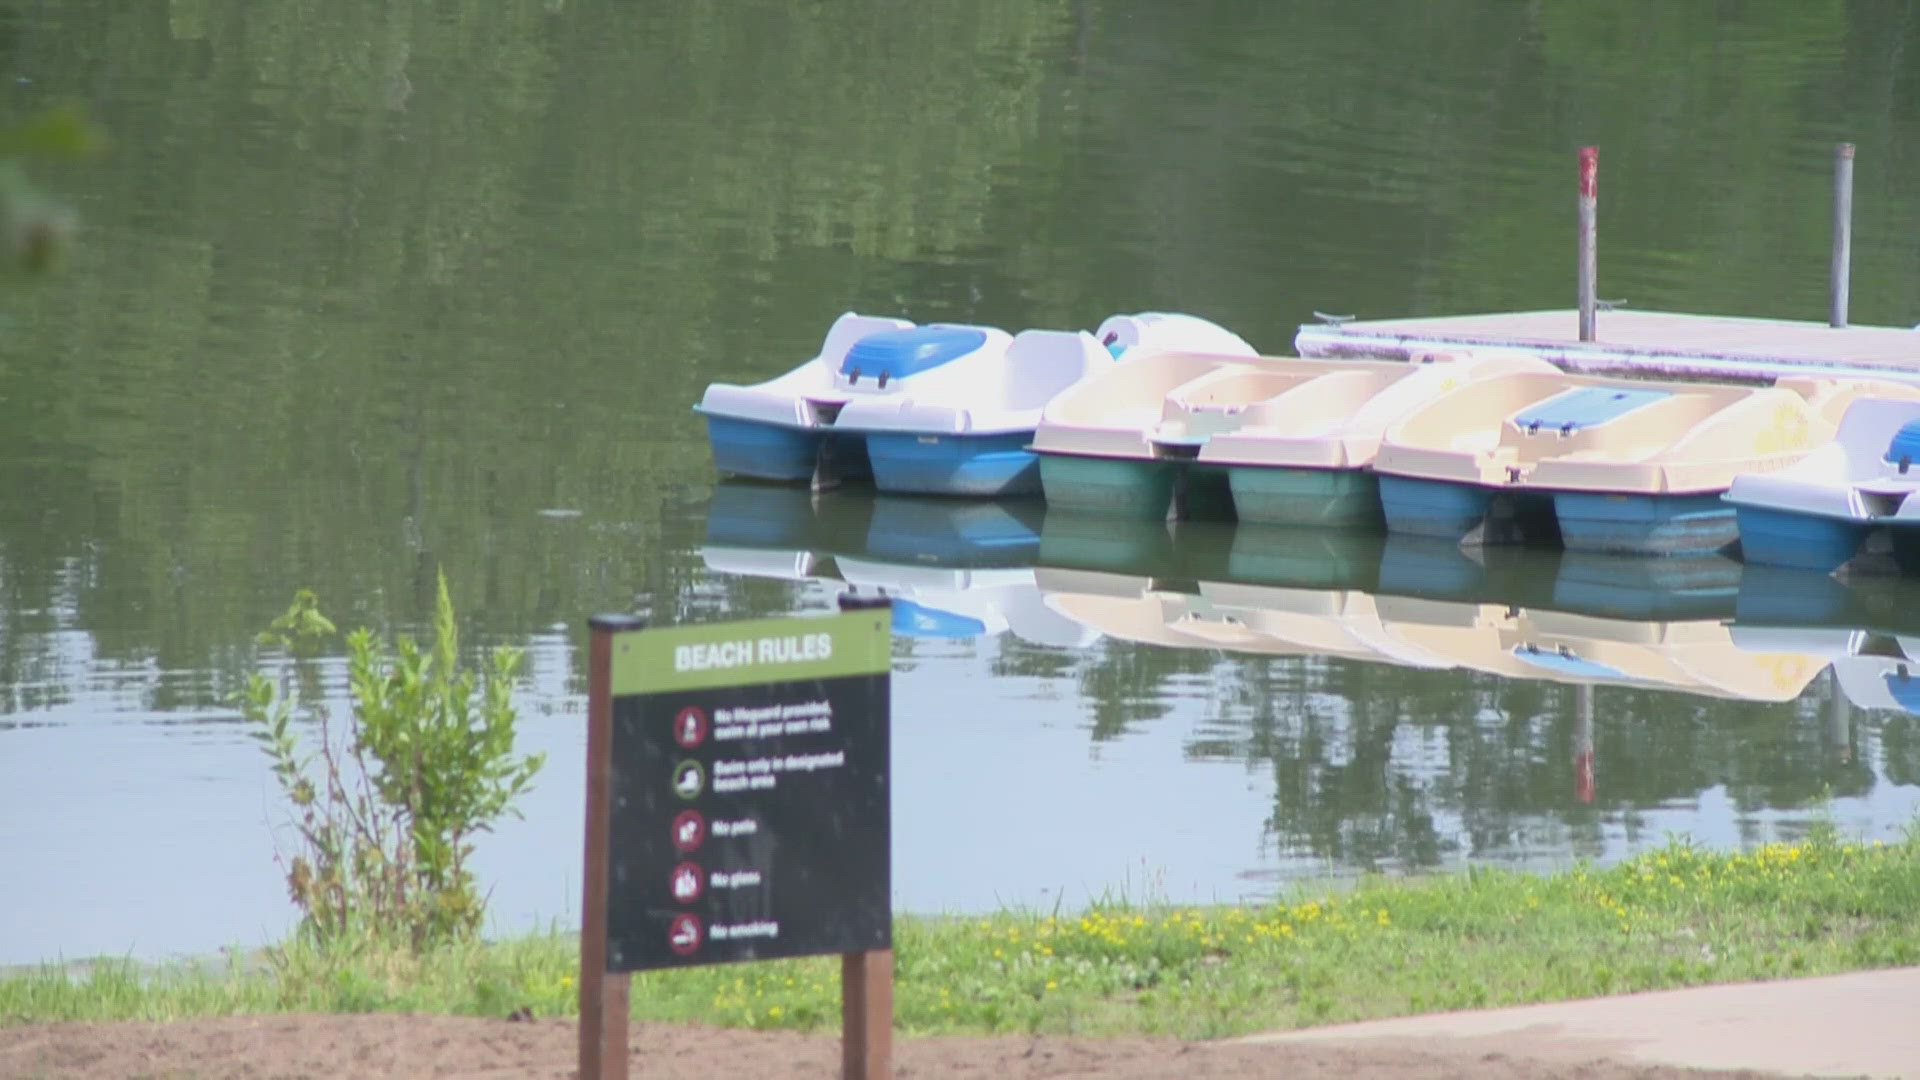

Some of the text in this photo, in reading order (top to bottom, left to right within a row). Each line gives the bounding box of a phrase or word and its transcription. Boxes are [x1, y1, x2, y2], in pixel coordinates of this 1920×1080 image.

[675, 633, 832, 671] BEACH RULES
[714, 709, 732, 723] No
[714, 726, 745, 740] swim
[759, 722, 783, 738] your
[784, 720, 808, 734] own
[713, 760, 746, 775] Swim
[747, 757, 770, 774] only
[784, 751, 844, 772] designated
[713, 774, 776, 792] beach area
[712, 819, 757, 837] No pets
[710, 871, 761, 889] No glass
[709, 921, 778, 939] No smoking
